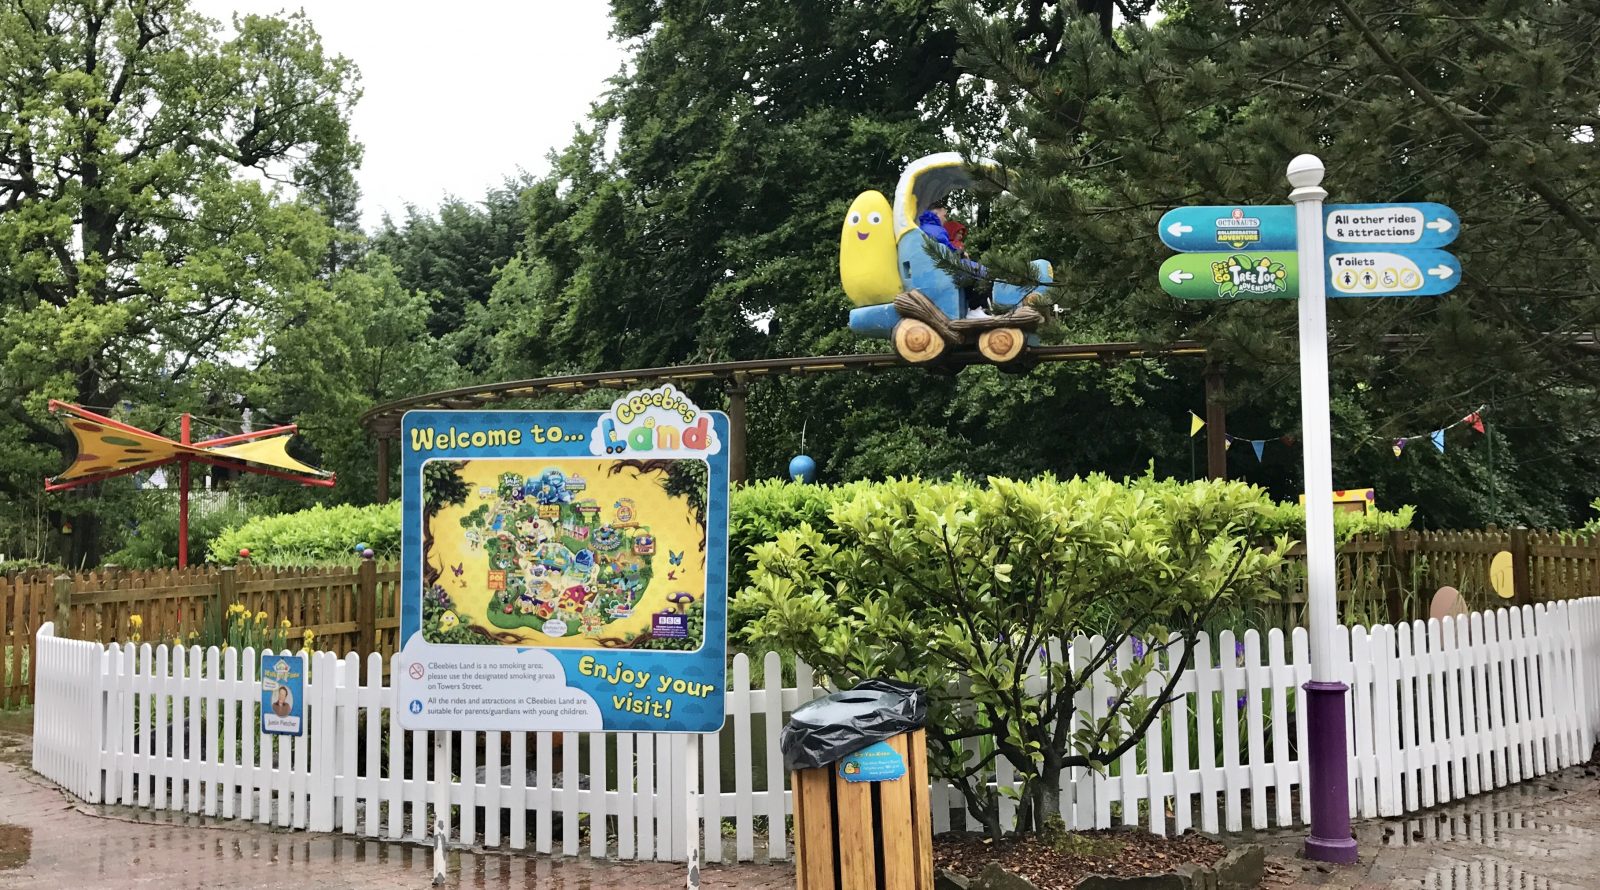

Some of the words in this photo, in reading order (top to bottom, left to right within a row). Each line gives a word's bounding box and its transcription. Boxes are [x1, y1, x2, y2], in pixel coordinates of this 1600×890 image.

[1335, 215, 1349, 224] All
[1352, 216, 1384, 224] other
[1388, 213, 1416, 223] rides
[1337, 228, 1344, 237] &
[1348, 227, 1415, 237] attractions
[1336, 257, 1375, 266] Toilets
[1238, 282, 1276, 292] ADVENTURE
[616, 387, 697, 425] CBeebies
[411, 426, 522, 451] Welcome
[530, 424, 585, 444] to...
[602, 416, 709, 454] Land
[659, 616, 681, 625] BBC
[499, 662, 526, 670] smoking
[428, 673, 447, 681] please
[474, 673, 508, 681] designated
[509, 673, 537, 681] smoking
[578, 655, 650, 689] Enjoy
[657, 675, 715, 698] your
[437, 682, 460, 690] Towers
[526, 697, 557, 705] CBeebies
[558, 697, 575, 705] Land
[612, 692, 673, 719] visit!
[428, 707, 452, 715] suitable
[453, 707, 463, 715] for
[464, 707, 521, 716] parents/guardians
